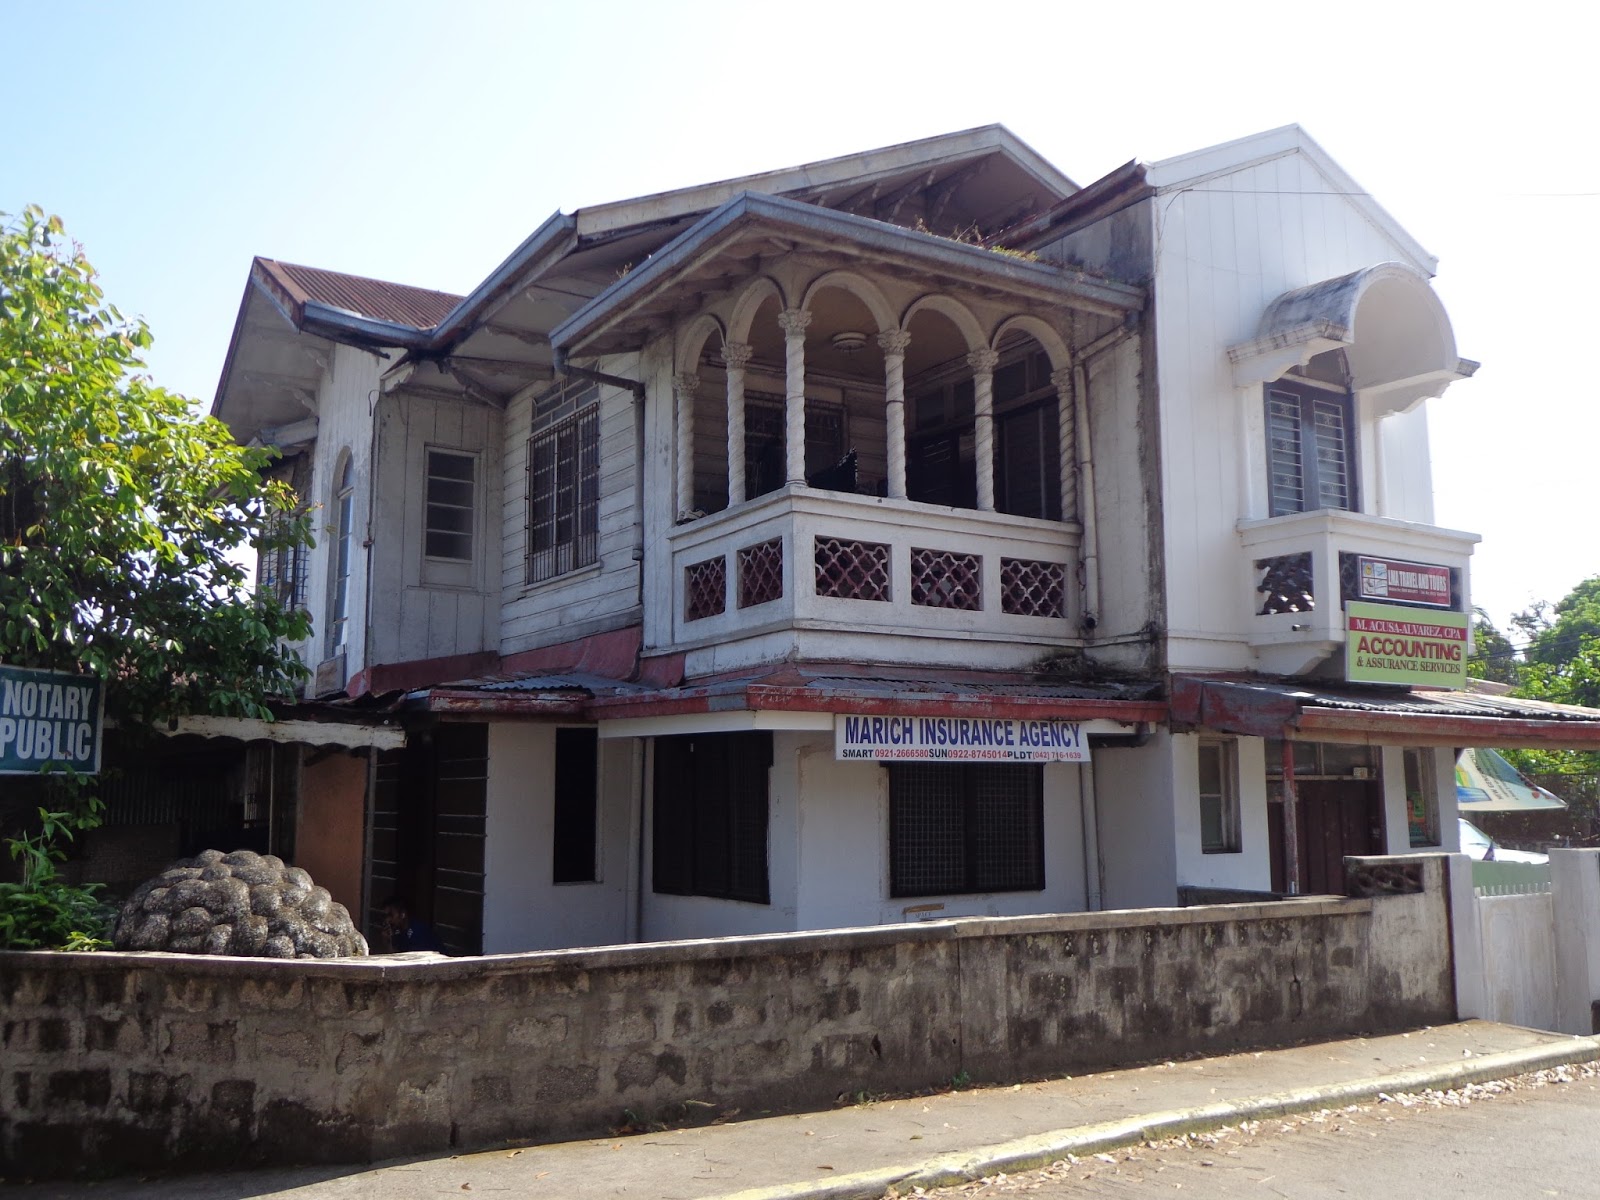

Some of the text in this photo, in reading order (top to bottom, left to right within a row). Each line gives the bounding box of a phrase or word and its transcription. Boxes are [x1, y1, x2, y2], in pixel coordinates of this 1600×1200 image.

[1399, 570, 1418, 589] TRAVEL
[1418, 573, 1429, 589] AND
[1429, 574, 1447, 591] TOURS
[1356, 619, 1461, 639] M. ACUSA-ALVAREZ, CPA
[1357, 636, 1461, 661] ACCOUNTING
[1357, 656, 1460, 673] & ASSURANCE SERVICES
[3, 679, 93, 720] NOTARY
[0, 717, 92, 761] PUBLIC
[845, 716, 1080, 747] MARICH INSURANCE AGENCY
[842, 749, 873, 758] SMART
[875, 749, 928, 758] 0921-2666580
[929, 748, 948, 758] SUN
[948, 749, 1008, 759] 0922-8745014
[1007, 750, 1032, 759] PLDT
